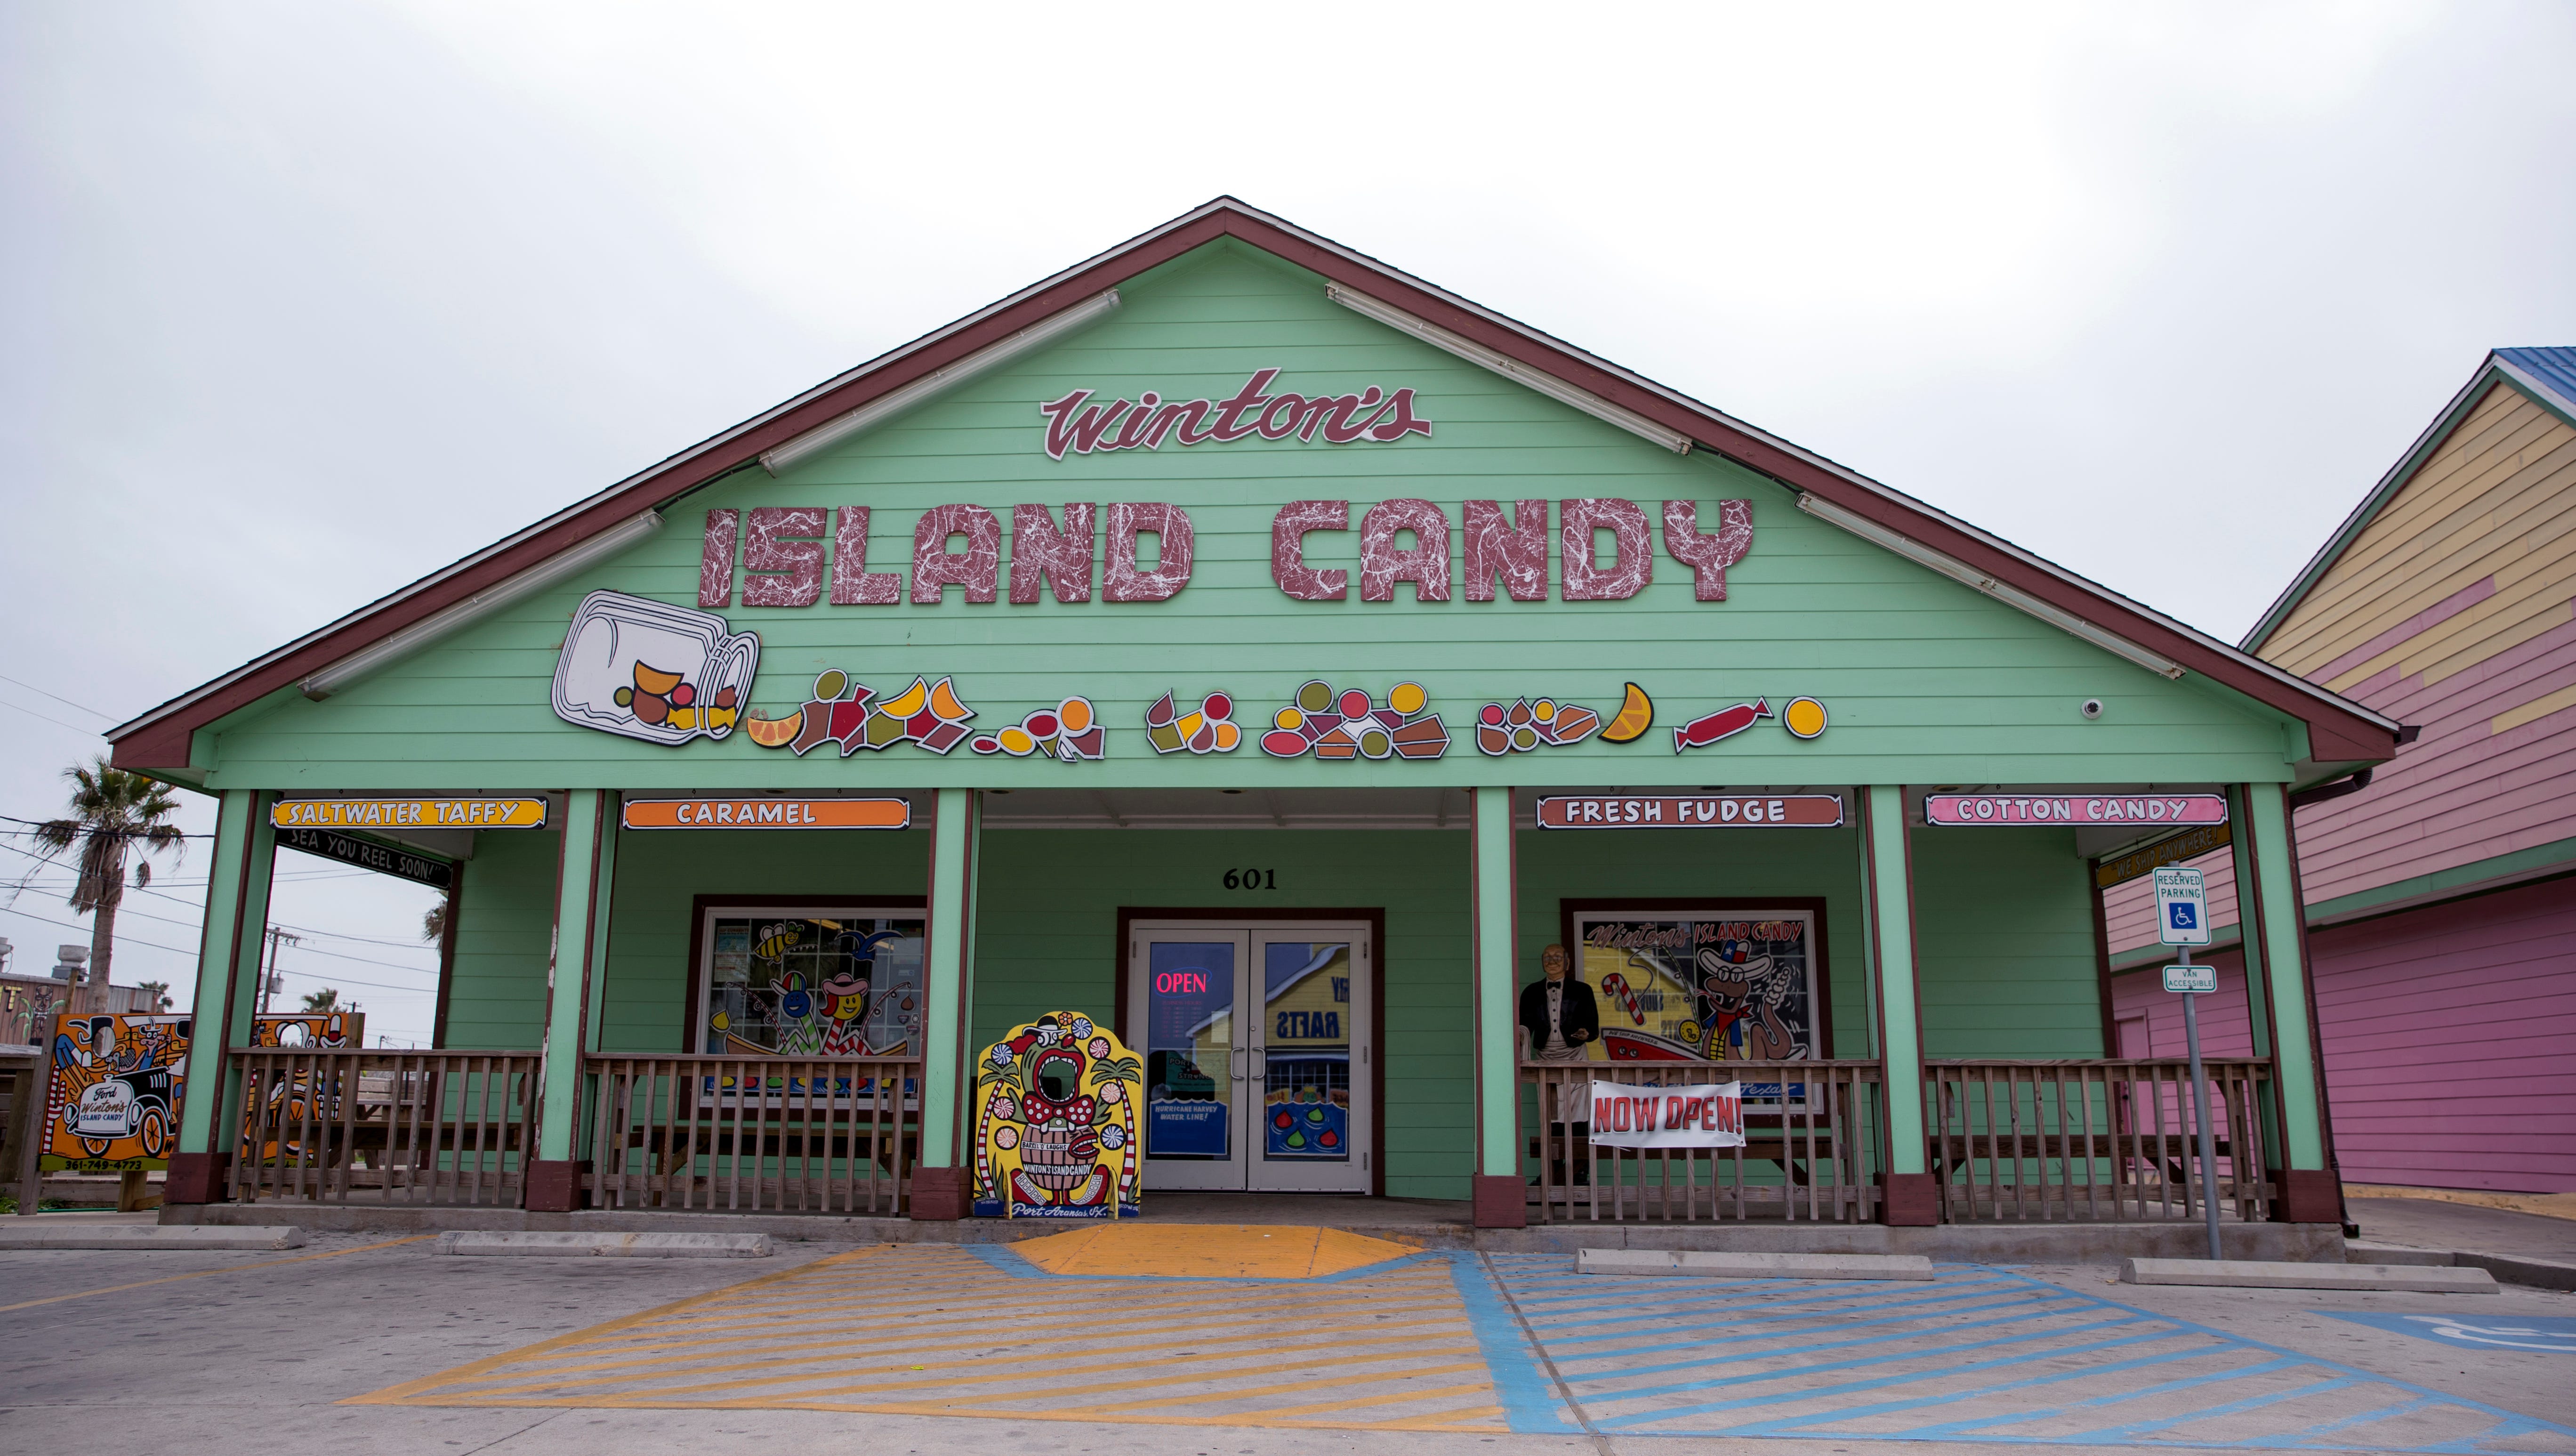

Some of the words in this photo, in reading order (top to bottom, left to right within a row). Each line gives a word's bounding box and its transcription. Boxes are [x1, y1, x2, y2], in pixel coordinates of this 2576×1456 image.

[1040, 368, 1432, 461] Winton's
[699, 502, 1195, 607] ISLAND
[1272, 499, 1753, 603] CANDY
[288, 802, 422, 824] SALTWATER
[435, 802, 520, 823] TAFFY
[676, 803, 817, 825] CARAMEL
[1566, 801, 1662, 823] FRESH
[1678, 800, 1785, 823] FUDGE
[1957, 799, 2072, 820] COTTON
[2086, 799, 2188, 821] CANDY
[328, 835, 356, 858] YOU
[361, 845, 392, 869] REEL
[2136, 849, 2156, 871] SHIP
[1223, 868, 1276, 890] 601
[2157, 875, 2200, 885] RESERVED
[2161, 889, 2200, 898] PARKING
[1586, 922, 1692, 950] Winton's
[1695, 922, 1748, 943] ISLAND
[1752, 922, 1803, 942] CANDY
[1156, 973, 1206, 993] OPEN
[94, 1085, 117, 1101] Ford
[1740, 1083, 1797, 1095] Texa
[81, 1100, 127, 1113] Winton's
[1186, 1113, 1209, 1122] LINE!
[1594, 1097, 1659, 1132] NOW
[1665, 1096, 1742, 1135] OPEN!
[65, 1160, 142, 1170] 361-749-4773
[1023, 1164, 1051, 1174] WINTON'S
[1070, 1164, 1091, 1175] CANDY
[1012, 1203, 1046, 1216] Port
[1045, 1206, 1088, 1216] Aransas,
